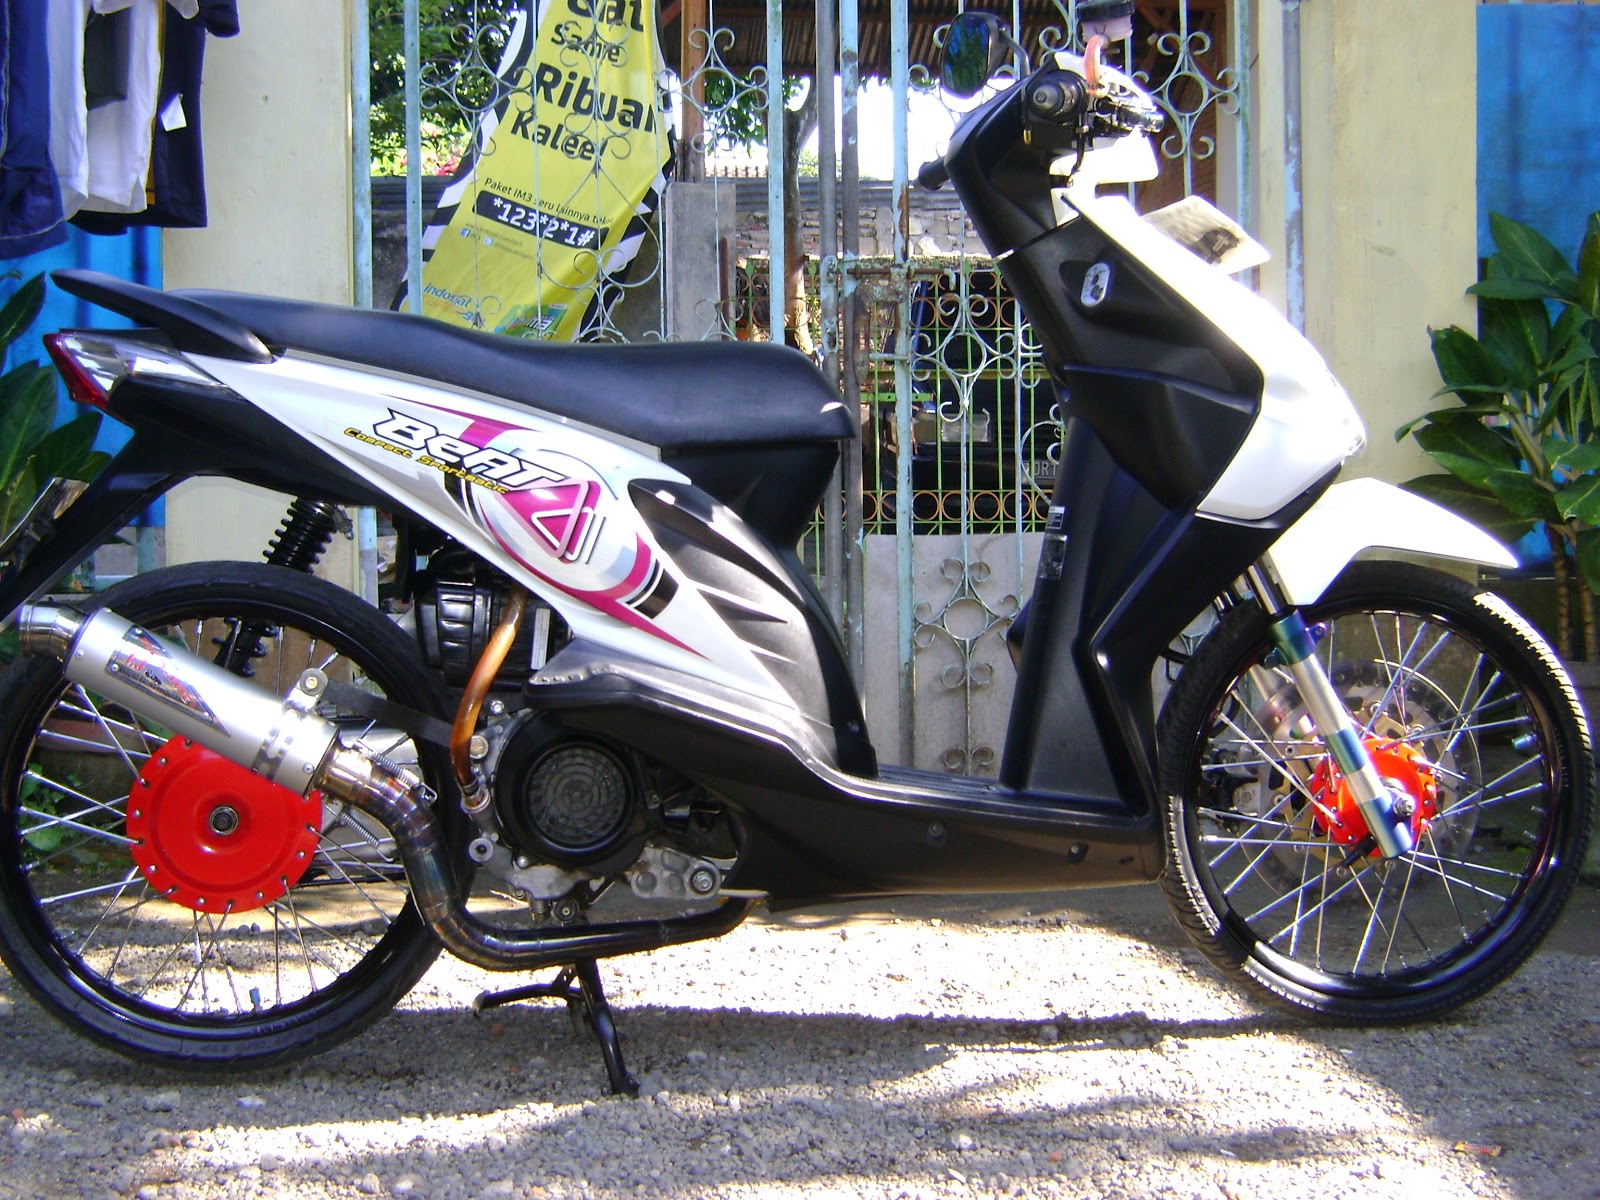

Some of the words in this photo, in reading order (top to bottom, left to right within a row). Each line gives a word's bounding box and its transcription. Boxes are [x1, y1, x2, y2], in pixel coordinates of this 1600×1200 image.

[484, 177, 512, 195] Paket
[513, 189, 533, 202] IM3
[423, 283, 472, 308] indosat
